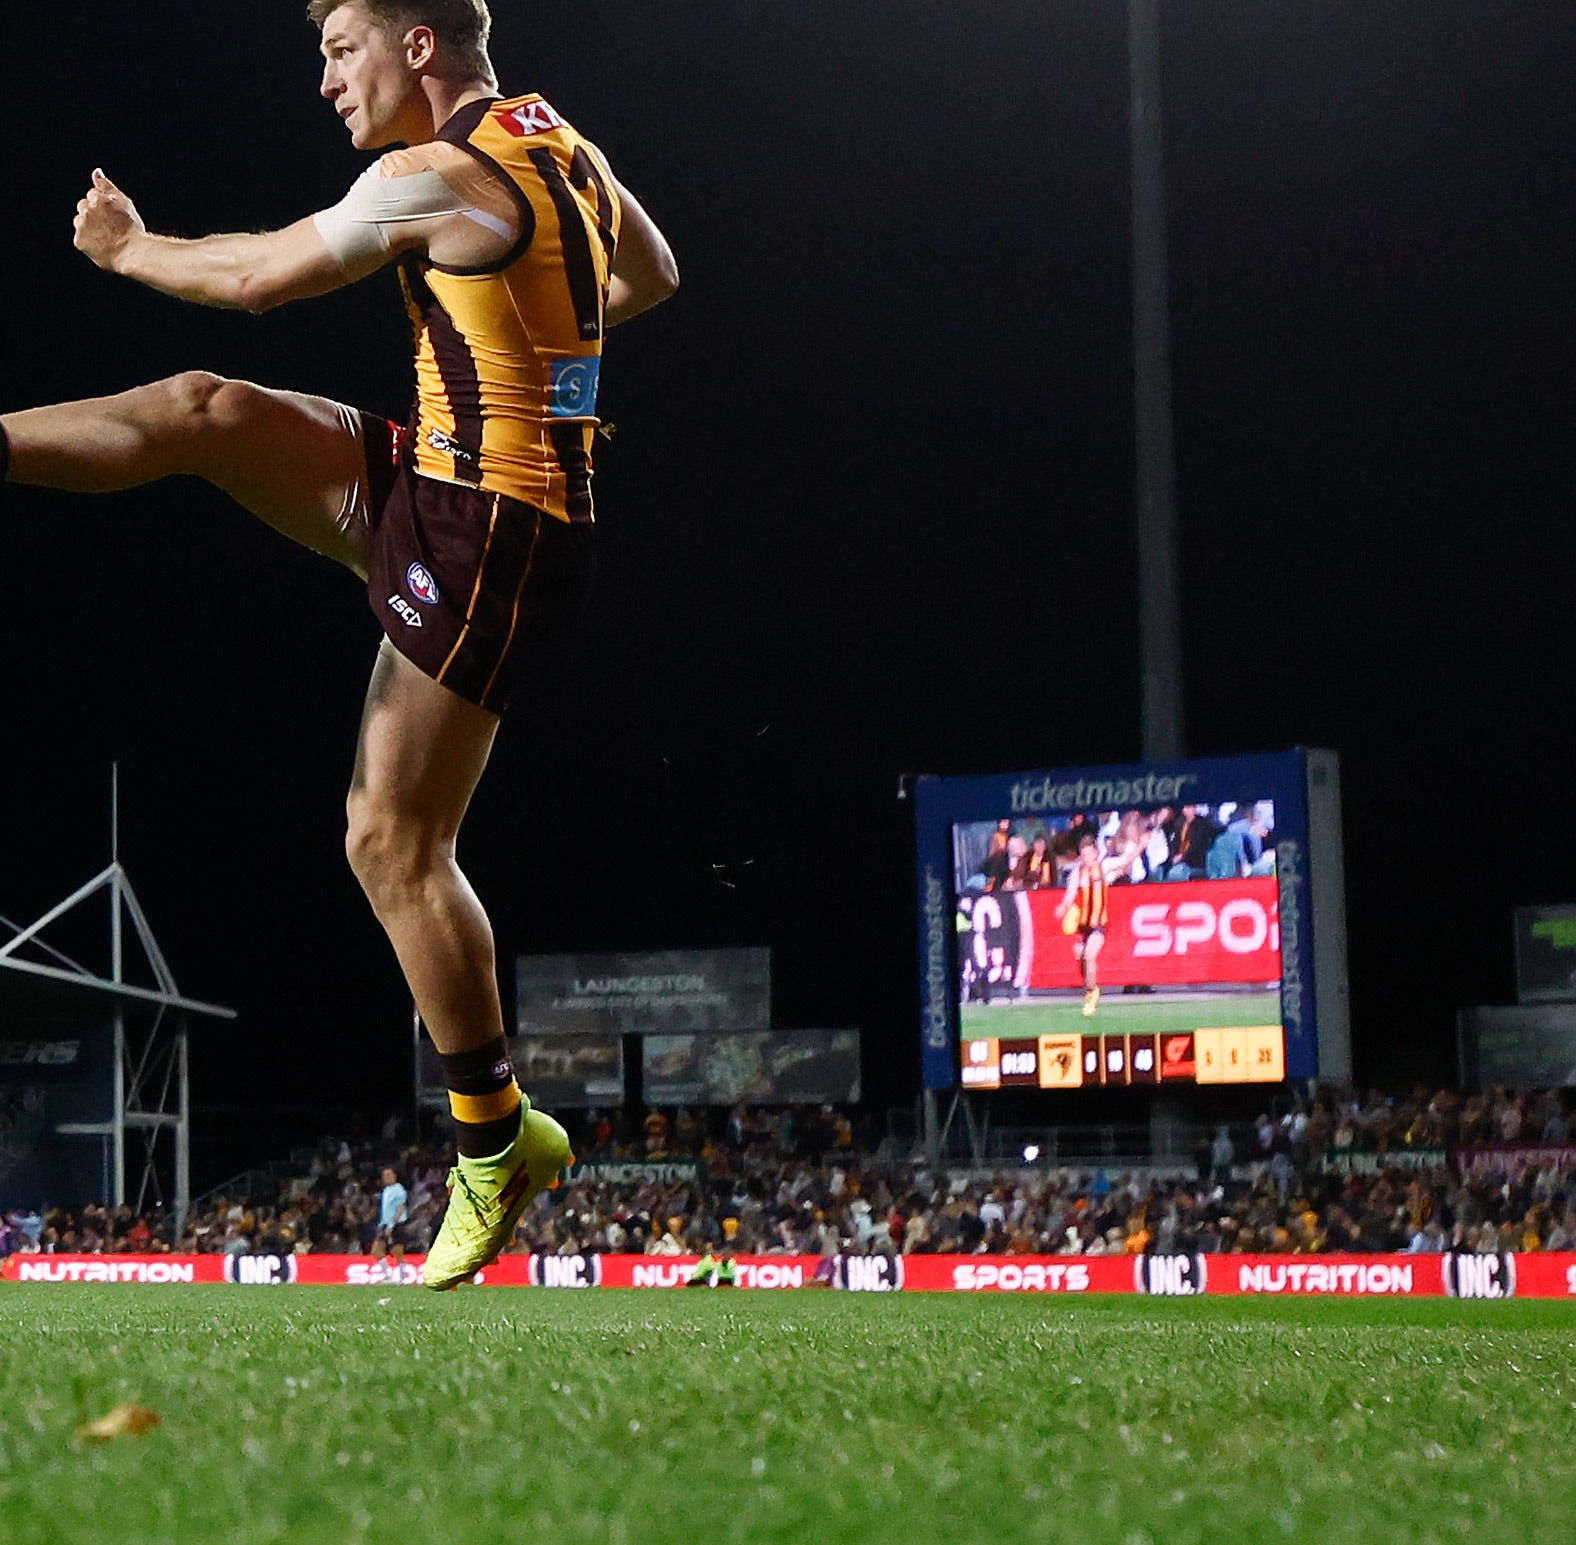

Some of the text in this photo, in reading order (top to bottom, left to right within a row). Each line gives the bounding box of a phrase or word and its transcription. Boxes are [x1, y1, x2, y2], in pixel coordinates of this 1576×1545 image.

[1010, 772, 1186, 812] ticketmaster
[1131, 897, 1279, 958] SPO
[574, 974, 706, 994] LAUNCESTON
[19, 1262, 194, 1283] NUTRITION
[953, 1264, 1090, 1291] SPORTS
[1239, 1264, 1413, 1294] NUTRITION
